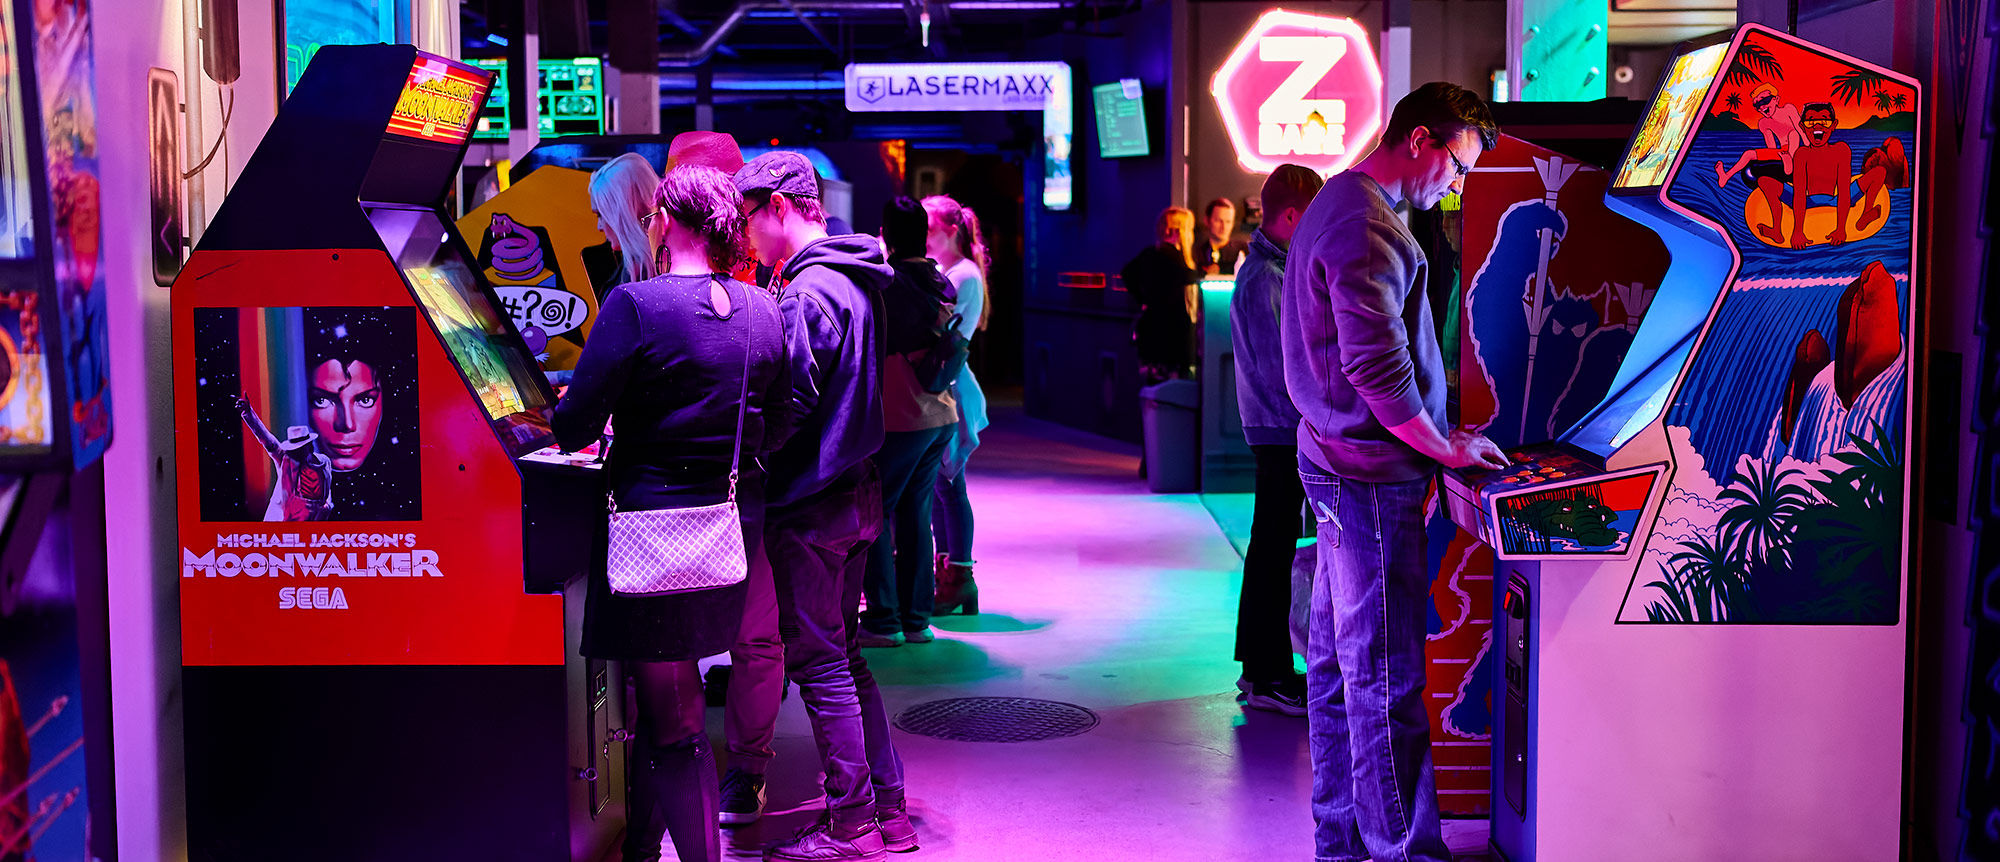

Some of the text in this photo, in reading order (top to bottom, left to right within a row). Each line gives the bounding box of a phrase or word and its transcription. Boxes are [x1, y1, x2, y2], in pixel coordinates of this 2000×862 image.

[888, 75, 1054, 97] LASERMAXX
[1259, 36, 1347, 124] Z
[217, 533, 416, 548] MICHAEL JACKSON'S
[183, 546, 444, 578] MOONWALKER
[279, 586, 348, 609] SEGA
